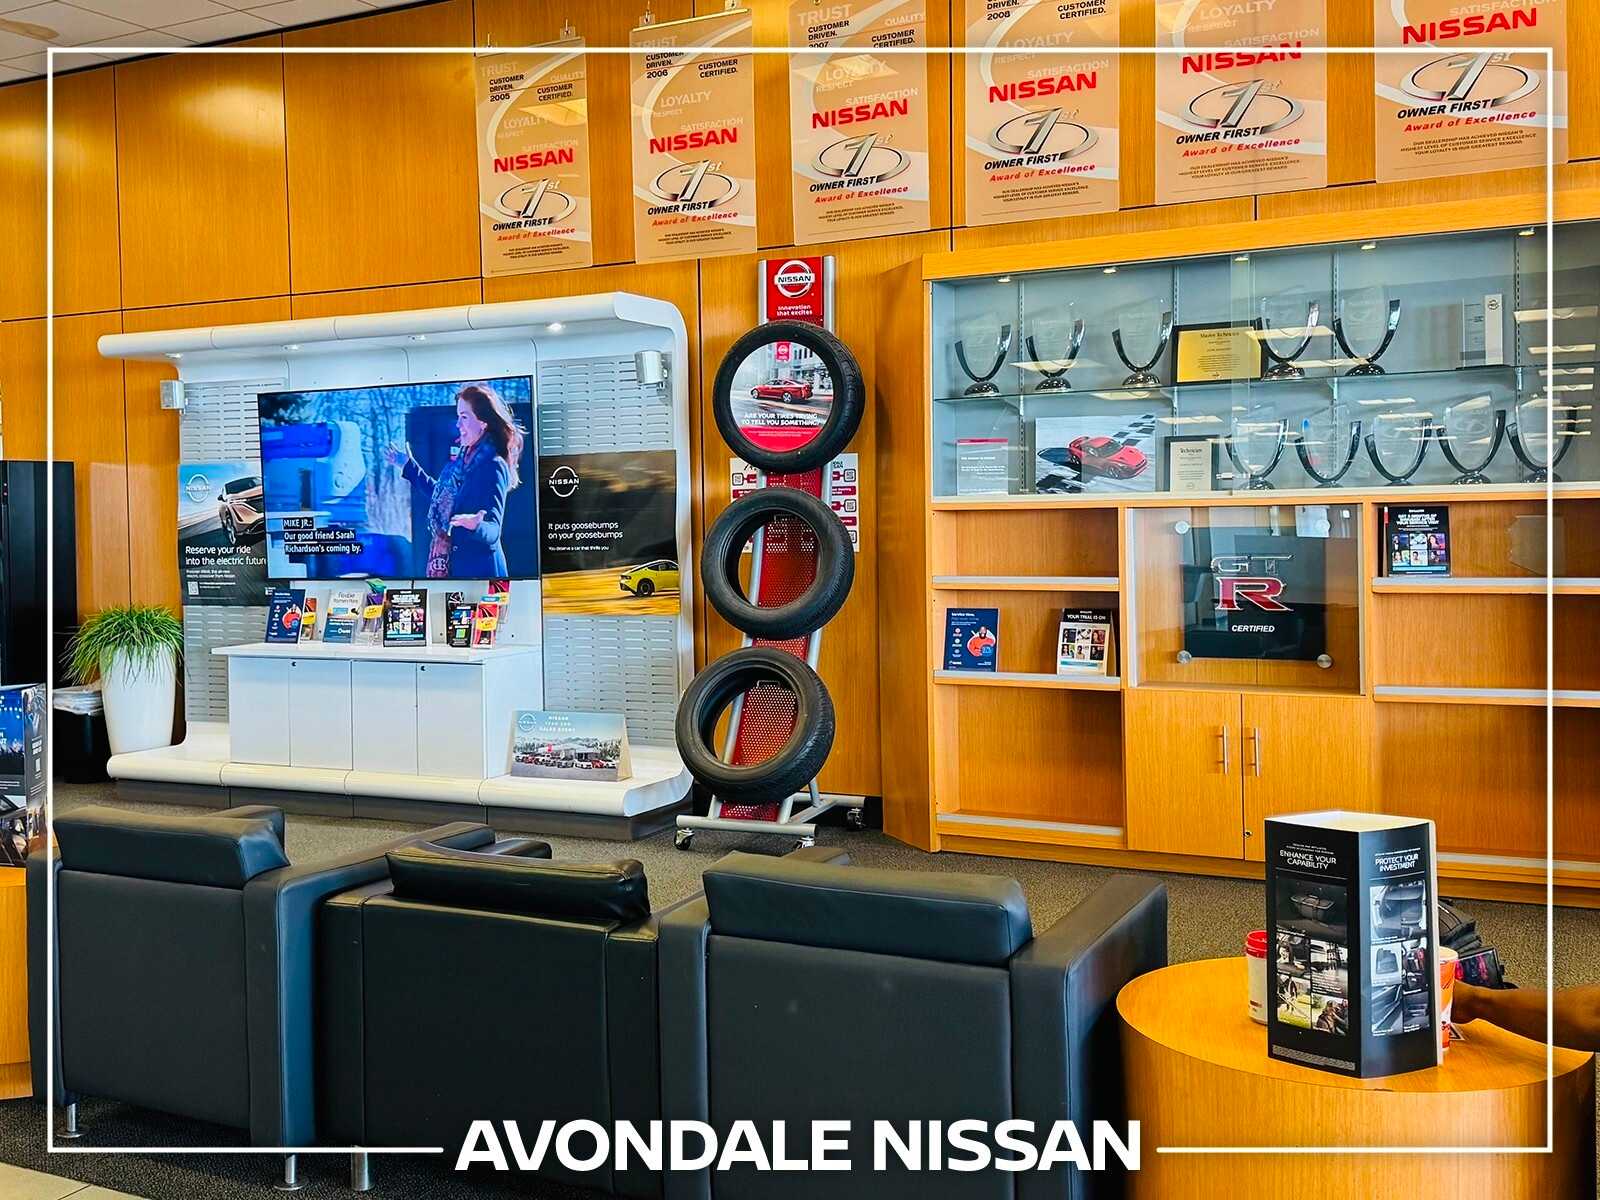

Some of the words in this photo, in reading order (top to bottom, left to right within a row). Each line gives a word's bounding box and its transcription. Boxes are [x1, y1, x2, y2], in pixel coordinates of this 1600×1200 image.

[986, 0, 1020, 10] DRIVEN.
[1057, 0, 1106, 12] CUSTOMER
[1201, 0, 1276, 20] LOYALTY
[798, 4, 852, 26] TRUST
[987, 11, 1010, 20] 2008
[1059, 7, 1106, 20] CERTIFIED.
[808, 20, 850, 33] CUSTOMER
[1403, 8, 1537, 44] NISSAN
[808, 30, 837, 41] DRIVEN.
[871, 29, 915, 42] CUSTOMER
[873, 37, 915, 48] CERTIFIED.
[1224, 27, 1320, 47] SATISFACTION
[698, 59, 738, 70] CUSTOMER
[1182, 41, 1302, 74] NISSAN
[646, 69, 668, 79] 2006
[1027, 59, 1109, 78] SATISFACTION
[489, 74, 524, 85] CUSTOMER
[537, 83, 573, 94] CUSTOMER
[989, 71, 1096, 103] NISSAN
[489, 93, 510, 102] 2005
[661, 91, 711, 108] LOYALTY
[846, 87, 919, 106] SATISFACTION
[812, 99, 908, 129] NISSAN
[1397, 105, 1445, 119] OWNER
[1450, 99, 1491, 113] FIRST
[681, 117, 744, 132] SATISFACTION
[1404, 121, 1443, 132] Award
[1447, 118, 1460, 127] of
[1465, 111, 1537, 125] Excellence
[650, 127, 737, 154] NISSAN
[1176, 131, 1220, 145] OWNER
[1223, 127, 1260, 140] FIRST
[1182, 147, 1216, 157] Award
[1221, 145, 1232, 153] of
[1237, 138, 1301, 151] Excellence
[494, 148, 574, 173] NISSAN
[984, 158, 1024, 170] OWNER
[1026, 153, 1060, 165] FIRST
[989, 172, 1021, 182] Award
[1024, 169, 1034, 178] of
[1038, 163, 1095, 176] Excellence
[809, 180, 844, 192] OWNER
[846, 176, 877, 187] FIRST
[815, 195, 842, 204] Award
[845, 191, 853, 199] of
[858, 186, 908, 198] Excellence
[647, 205, 680, 215] OWNER
[682, 201, 709, 212] FIRST
[492, 221, 522, 231] OWNER
[524, 217, 548, 228] FIRST
[651, 218, 677, 226] Award
[692, 212, 738, 222] Excellence
[497, 233, 520, 241] Award
[533, 227, 576, 237] Excellence
[778, 275, 811, 283] NISSAN
[283, 519, 300, 527] MIKE
[301, 519, 312, 528] JR.:
[548, 522, 553, 530] It
[554, 522, 570, 531] puts
[571, 521, 619, 531] goosebumps
[284, 532, 297, 540] Our
[297, 531, 313, 541] good
[315, 531, 334, 539] friend
[336, 530, 355, 539] Sarah
[558, 532, 574, 540] your
[575, 531, 623, 540] goosebumps
[185, 545, 216, 554] Reserve
[217, 546, 234, 555] your
[236, 545, 251, 554] ride
[285, 544, 325, 553] Richardson's
[326, 544, 350, 554] coming
[351, 544, 362, 554] by.
[185, 557, 200, 565] into
[202, 557, 215, 565] the
[216, 556, 244, 565] electric
[246, 556, 267, 565] futur
[1215, 577, 1294, 611] R
[1231, 624, 1275, 633] CERTIFIED
[1280, 849, 1314, 861] ENHANCE
[1315, 855, 1337, 865] YOUR
[1287, 857, 1329, 870] CAPABILITY
[1375, 855, 1404, 865] PROTECT
[1404, 853, 1419, 861] YOUR
[1379, 860, 1416, 872] INVESTMENT
